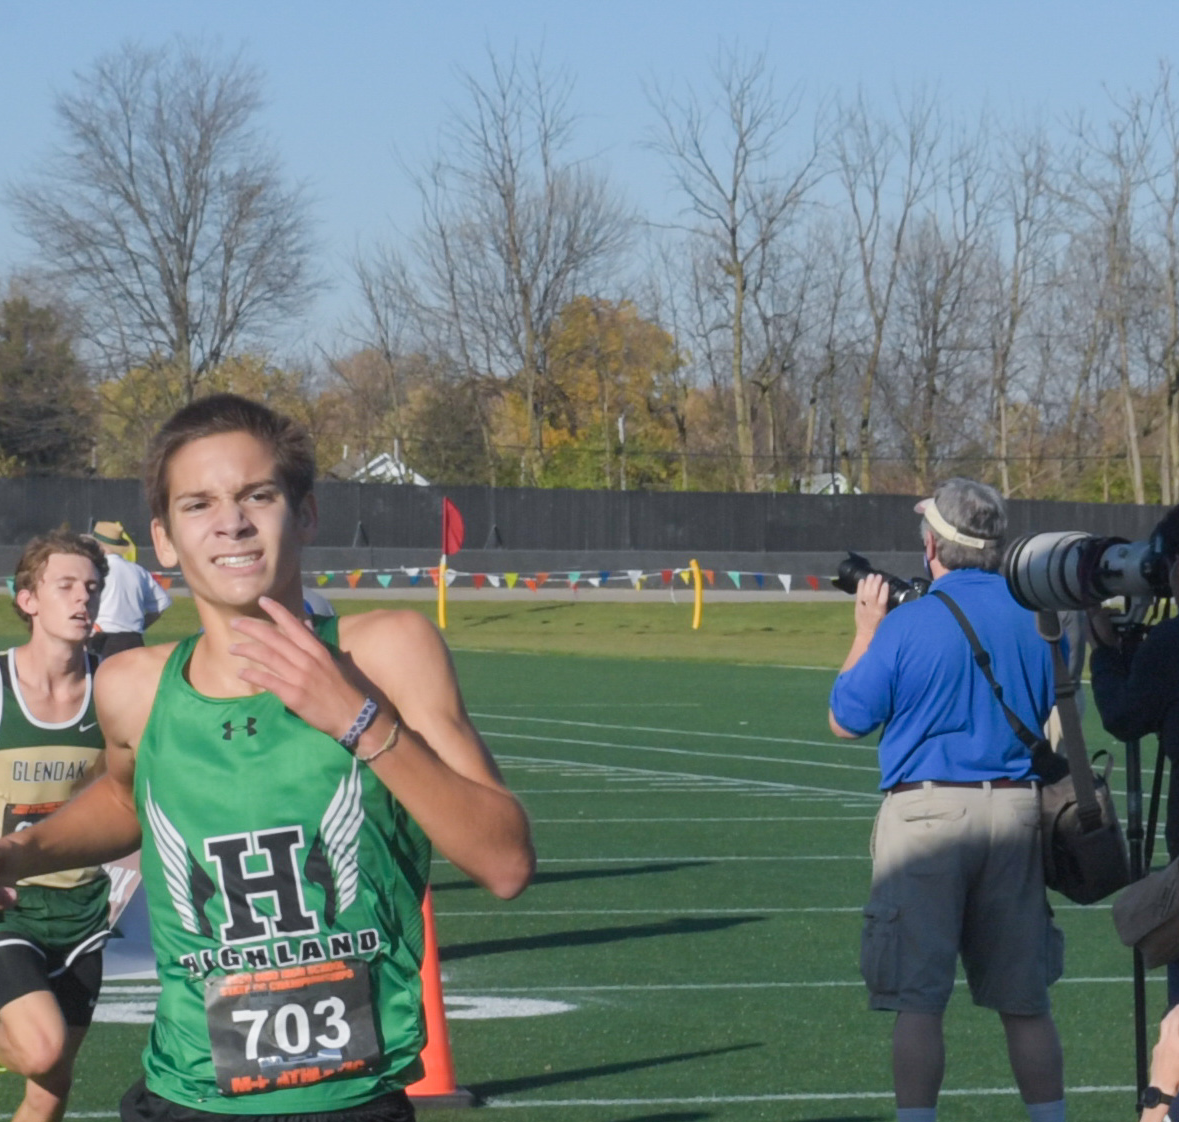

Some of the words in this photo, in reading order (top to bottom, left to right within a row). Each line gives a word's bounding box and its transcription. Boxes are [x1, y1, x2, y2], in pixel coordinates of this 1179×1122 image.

[12, 760, 88, 783] GLENOAK
[203, 824, 320, 945] H
[180, 928, 380, 978] HIGHLAND
[231, 996, 351, 1060] 703
